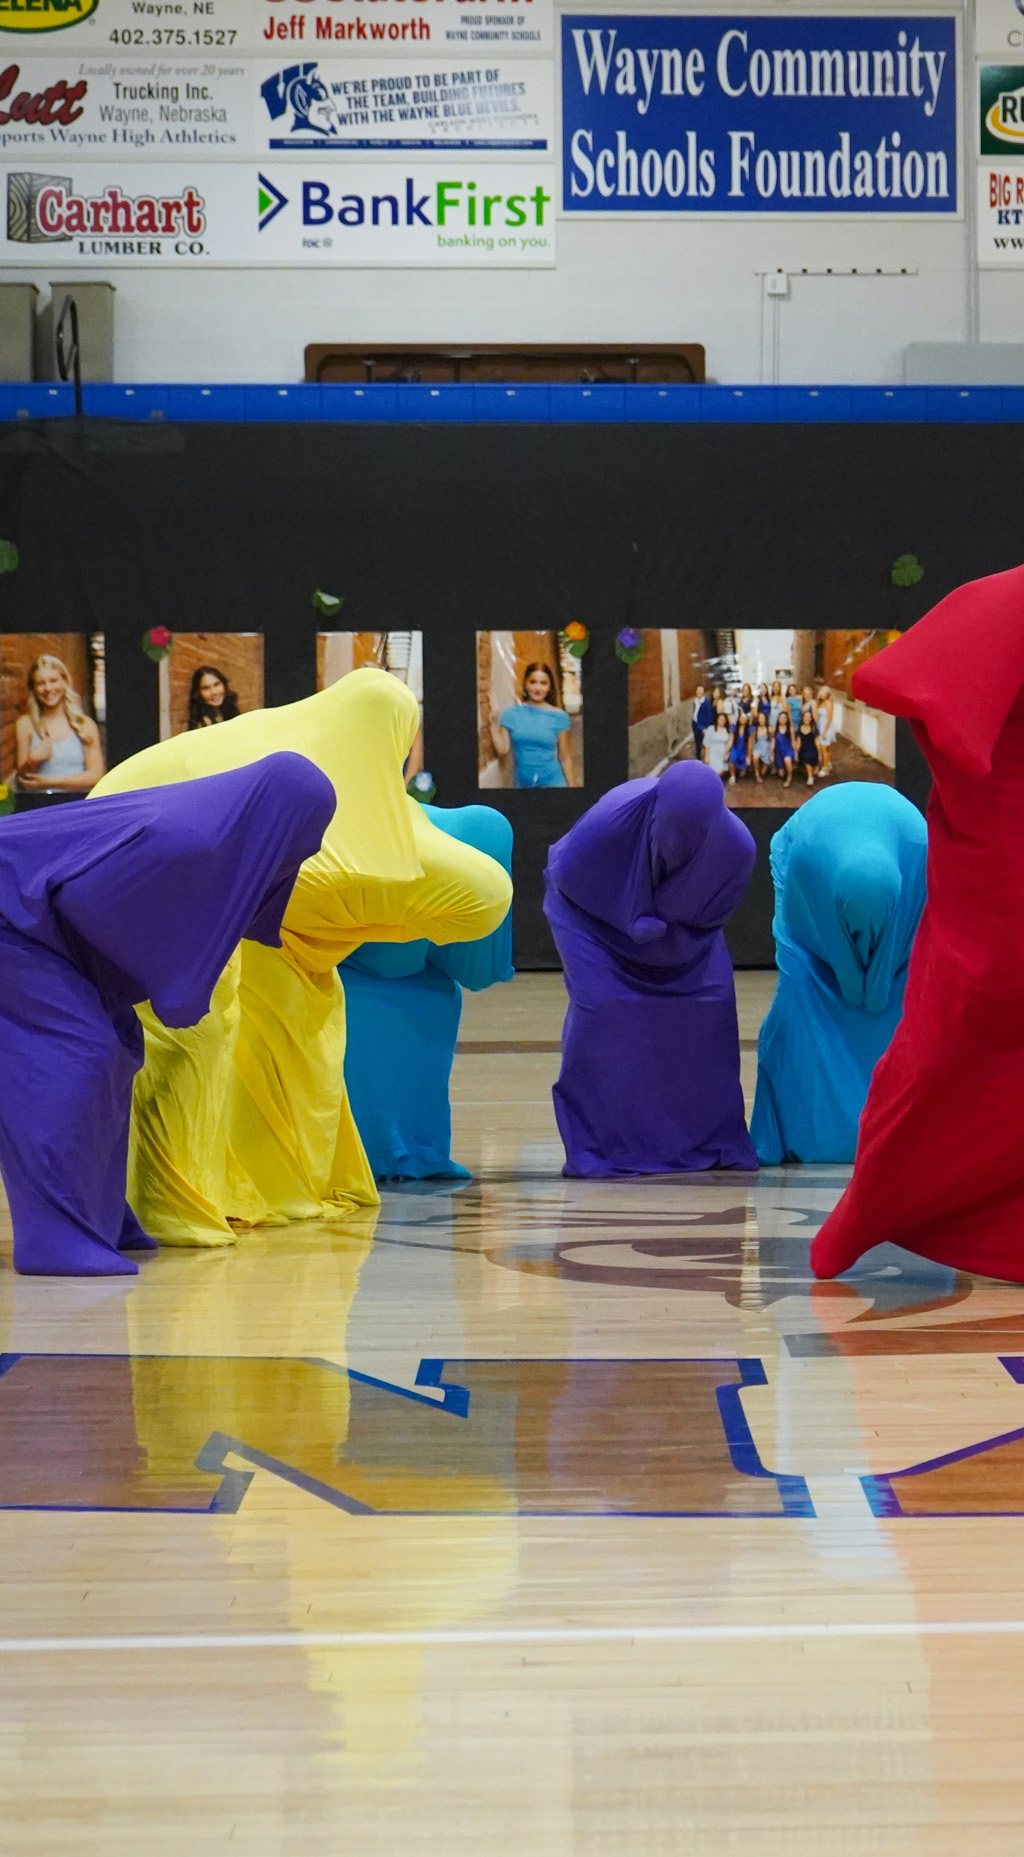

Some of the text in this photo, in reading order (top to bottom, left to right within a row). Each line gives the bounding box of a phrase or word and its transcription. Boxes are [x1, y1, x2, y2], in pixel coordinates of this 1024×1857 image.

[132, 0, 215, 16] Wayne, NE
[264, 15, 431, 40] Jeff Markworth
[461, 15, 482, 26] PROUD
[109, 29, 238, 45] 402.375.1527
[471, 30, 509, 41] COMMUNITY
[79, 63, 117, 77] Locally
[201, 64, 215, 75] 20
[217, 66, 246, 78] years
[571, 29, 947, 117] Wayne Community
[112, 82, 213, 101] Trucking Inc.
[331, 68, 501, 96] WE'RE PROUD TO BE PART OF
[346, 95, 369, 110] THE
[413, 87, 472, 104] BUILDING
[100, 105, 227, 124] Wayne, Nebraska
[337, 111, 369, 126] WITH
[373, 109, 395, 123] THE
[399, 106, 439, 121] WAYNE
[443, 102, 472, 118] BLUE
[50, 129, 107, 147] Wayne
[113, 129, 155, 147] High
[160, 129, 236, 145] Athletics
[570, 129, 949, 198] Schools Foundation
[989, 173, 1011, 209] BIG
[39, 189, 202, 233] Carhart
[302, 177, 551, 226] BankFirst
[78, 241, 210, 255] LUMBER CO.
[437, 234, 551, 251] banking on you.
